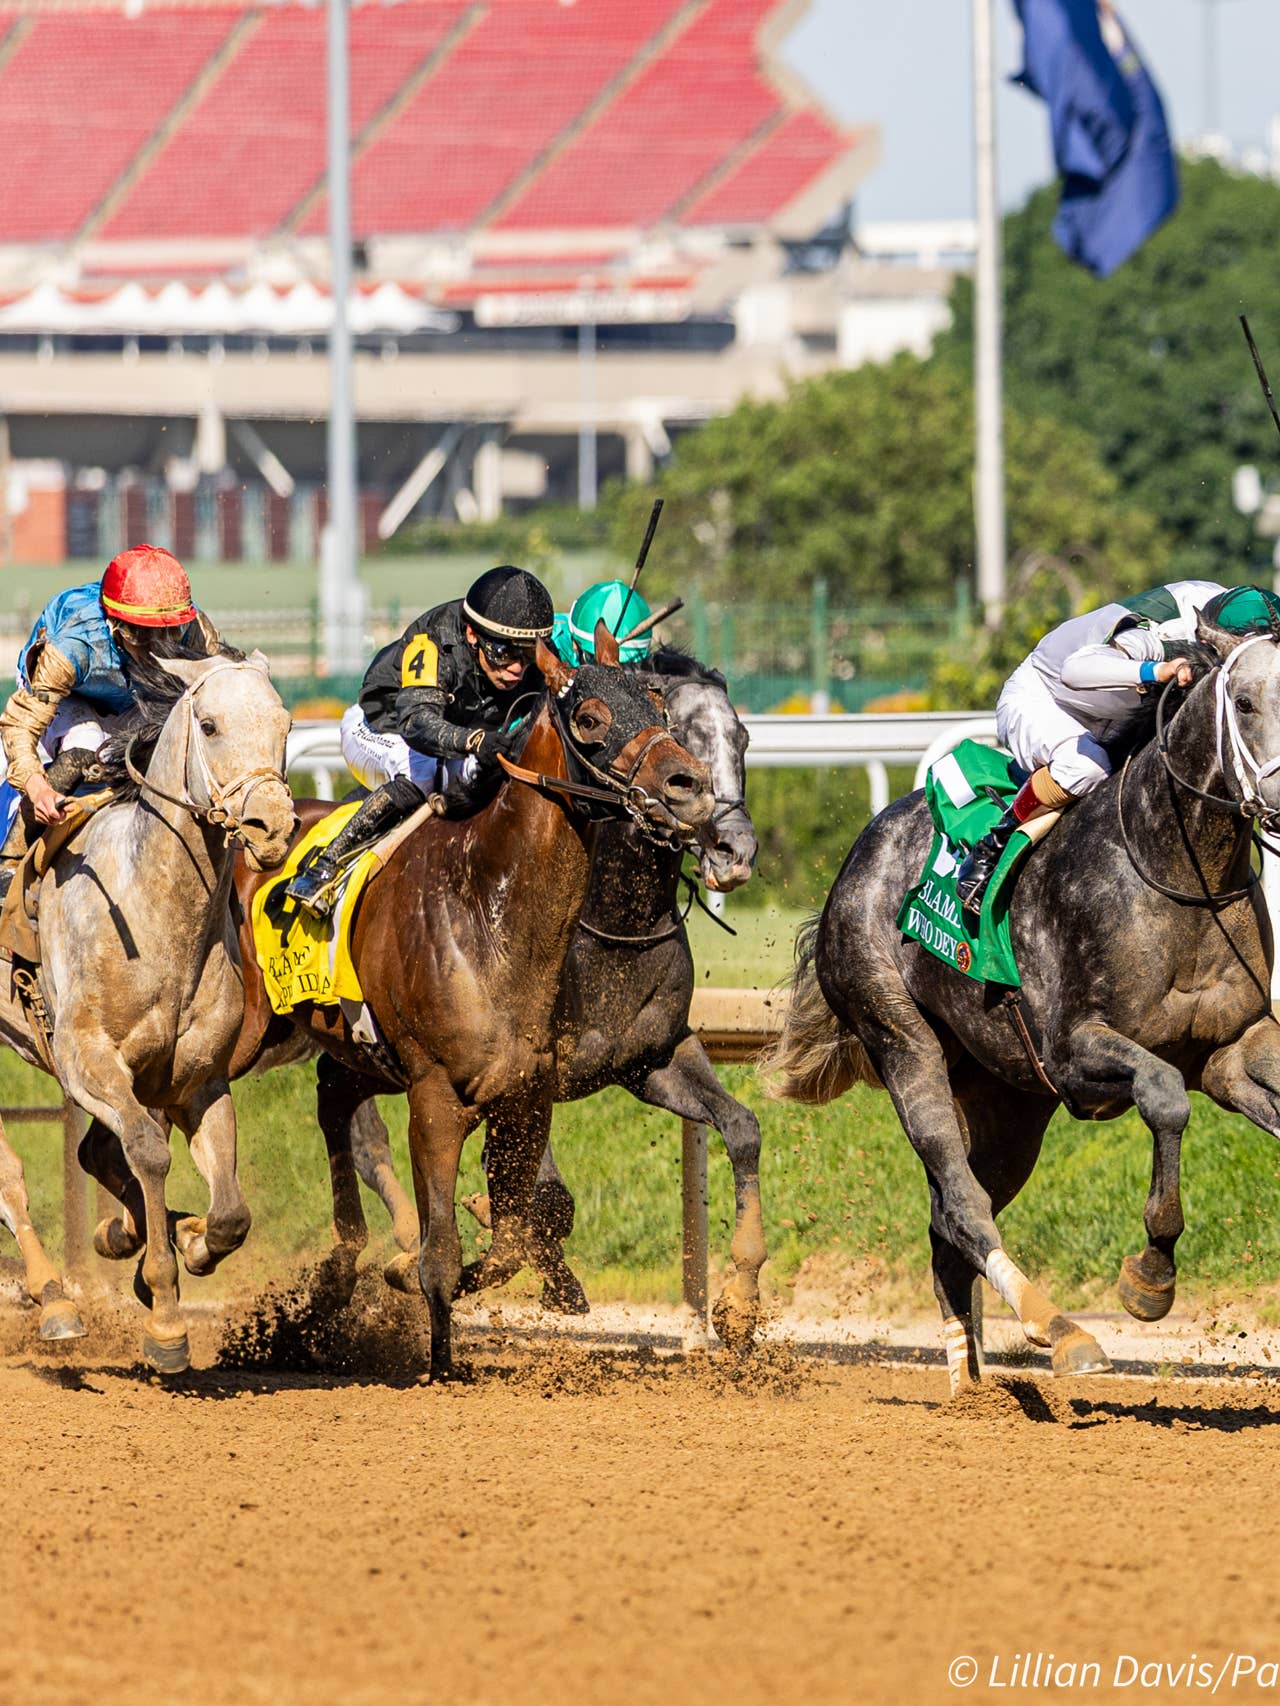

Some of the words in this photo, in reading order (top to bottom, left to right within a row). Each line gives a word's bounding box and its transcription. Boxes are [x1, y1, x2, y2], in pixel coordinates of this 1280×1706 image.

[408, 649, 425, 679] 4
[907, 906, 934, 944] WHO
[932, 926, 958, 961] DEY
